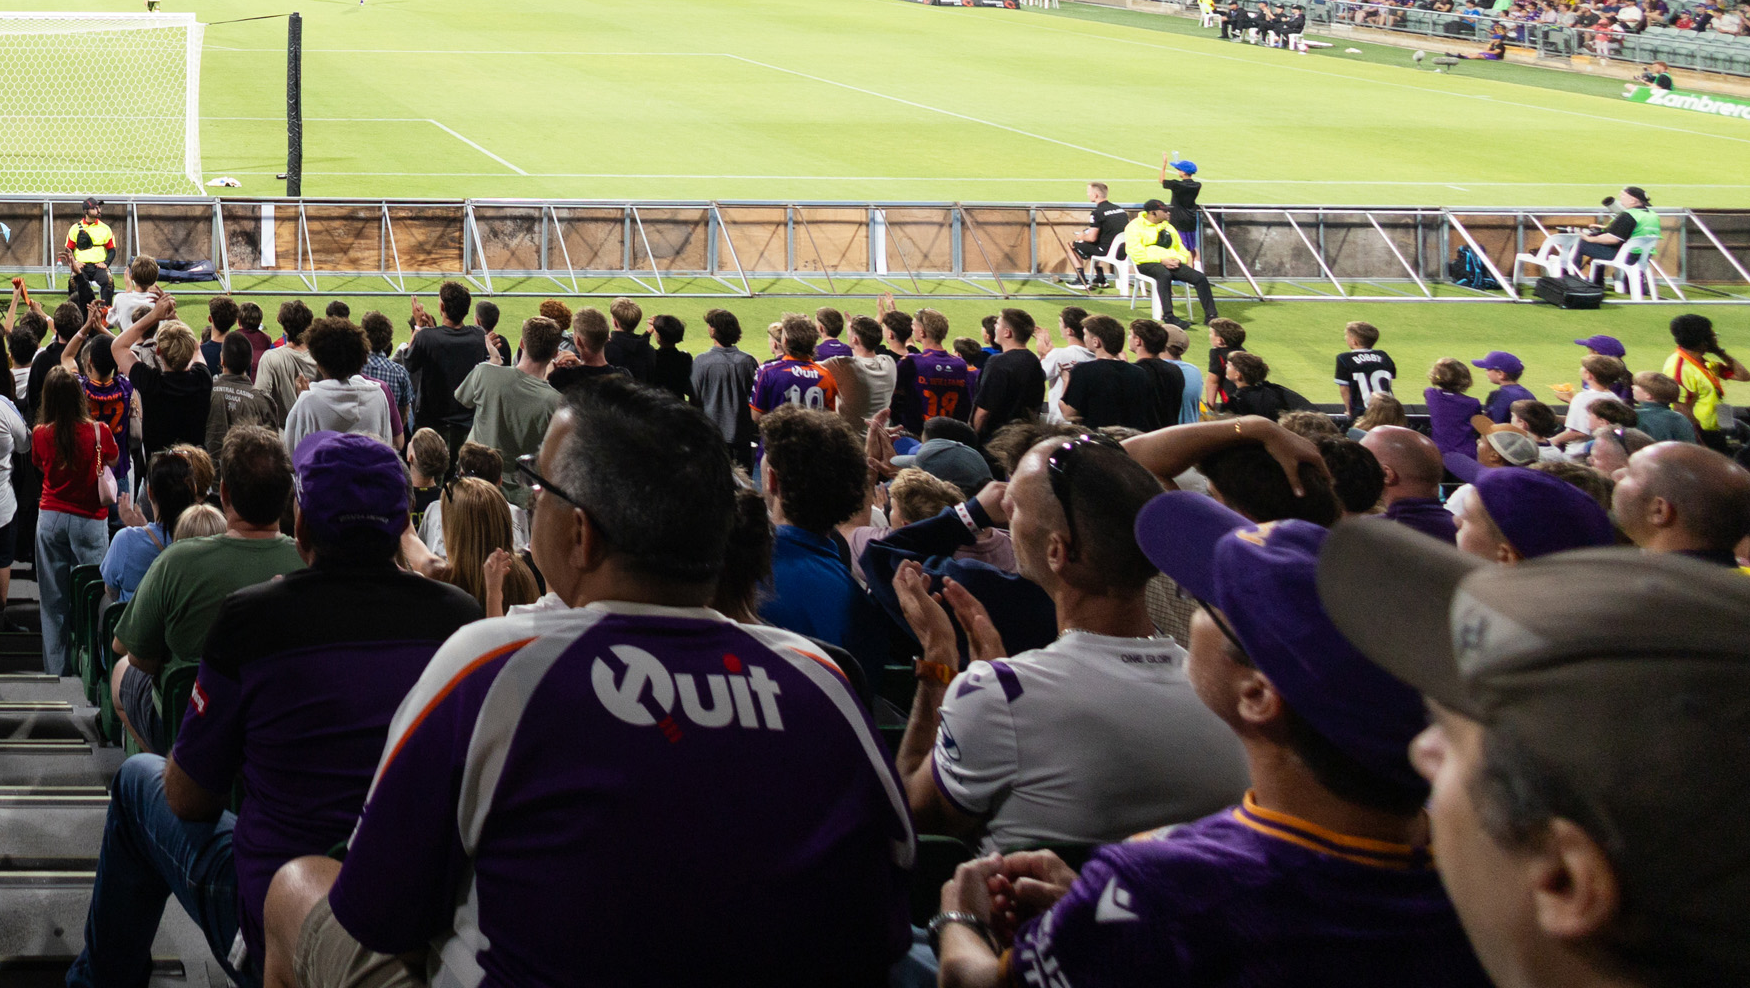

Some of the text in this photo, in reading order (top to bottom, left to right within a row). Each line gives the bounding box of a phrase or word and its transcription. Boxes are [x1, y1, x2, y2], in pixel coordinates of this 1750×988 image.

[1646, 89, 1750, 119] Zambrero
[1352, 354, 1383, 364] BOBBY
[792, 364, 819, 379] Quit
[212, 386, 235, 395] CENTRAL
[784, 383, 825, 410] 10
[1352, 370, 1394, 408] 10
[225, 394, 241, 403] OSAKA
[1121, 654, 1143, 664] ONE
[591, 644, 786, 737] Quit
